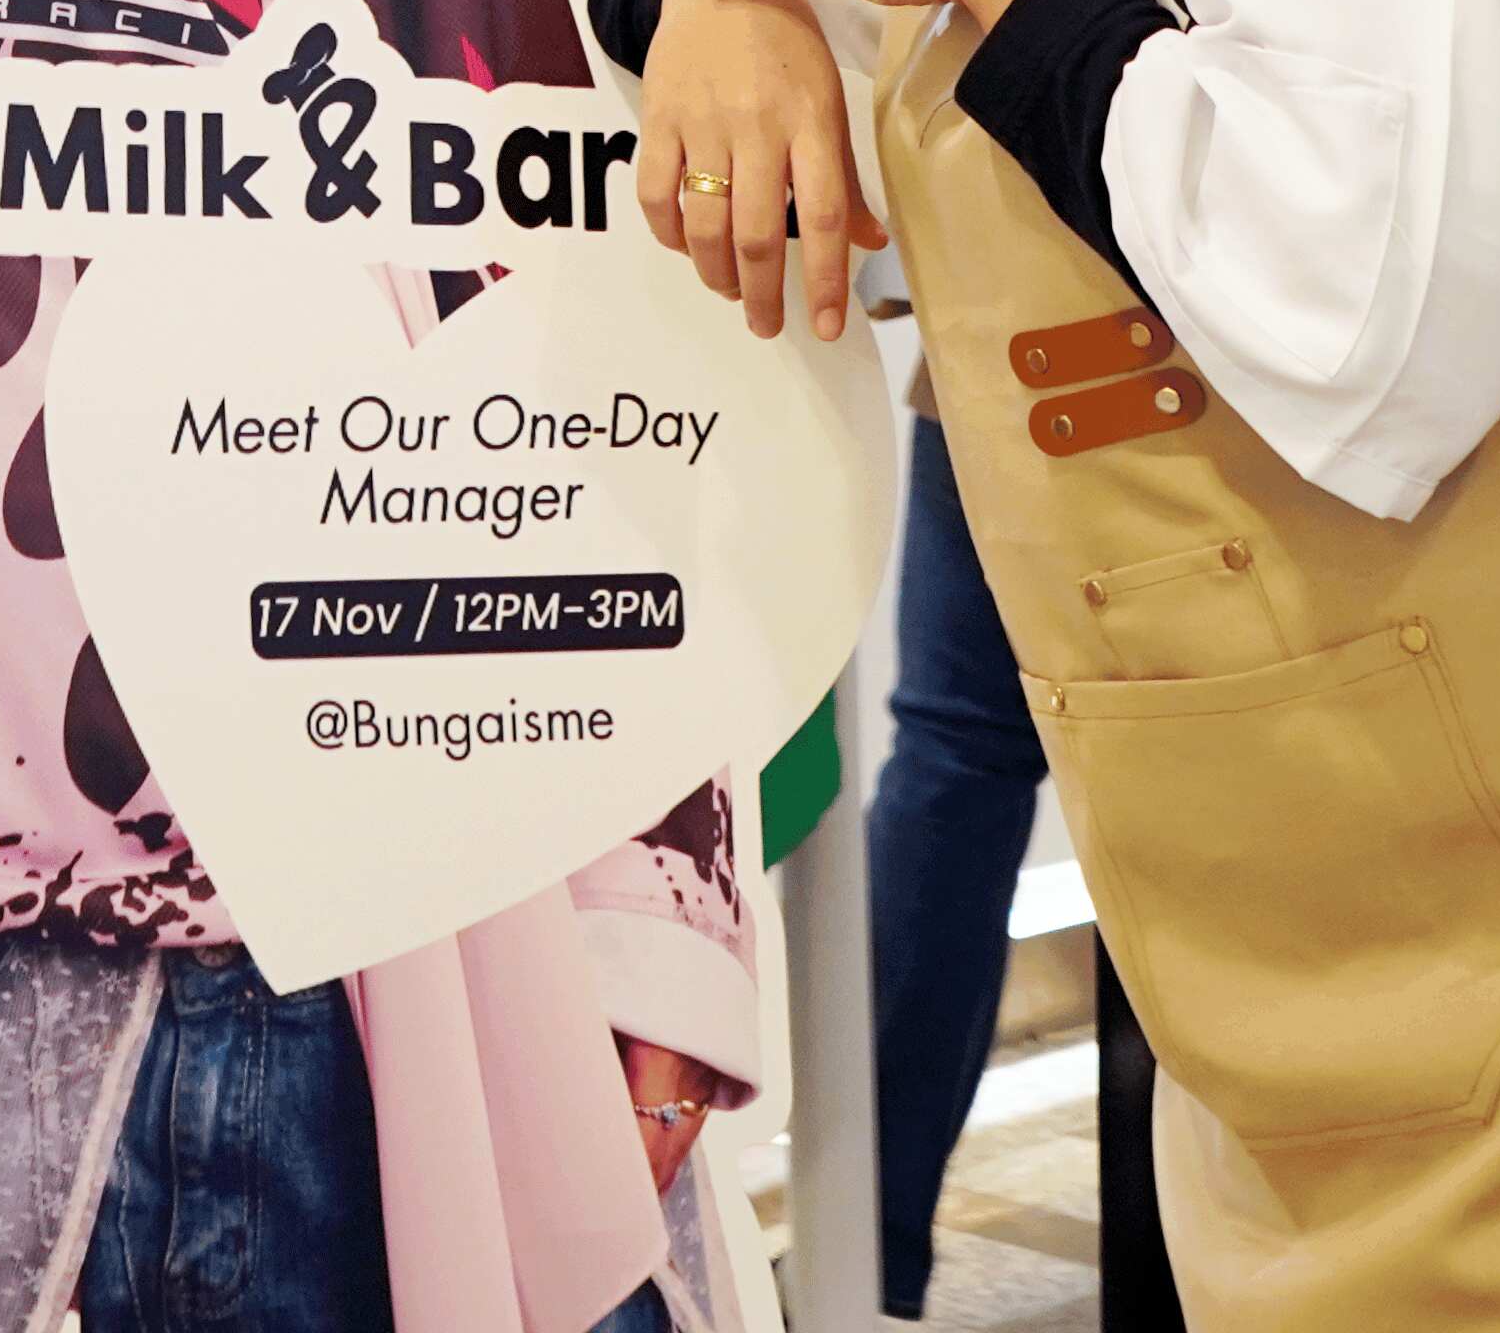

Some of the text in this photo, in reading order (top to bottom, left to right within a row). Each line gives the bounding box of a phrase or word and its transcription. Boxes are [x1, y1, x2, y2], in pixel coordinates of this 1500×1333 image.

[0, 103, 273, 221] Milk
[410, 121, 638, 232] Bar
[170, 391, 720, 466] Meet Our One-Day
[319, 467, 585, 540] Manager
[256, 596, 299, 638] 17
[311, 595, 403, 637] Nov
[452, 587, 680, 634] 12PM-3PM
[306, 697, 615, 761] @Bungaisme
